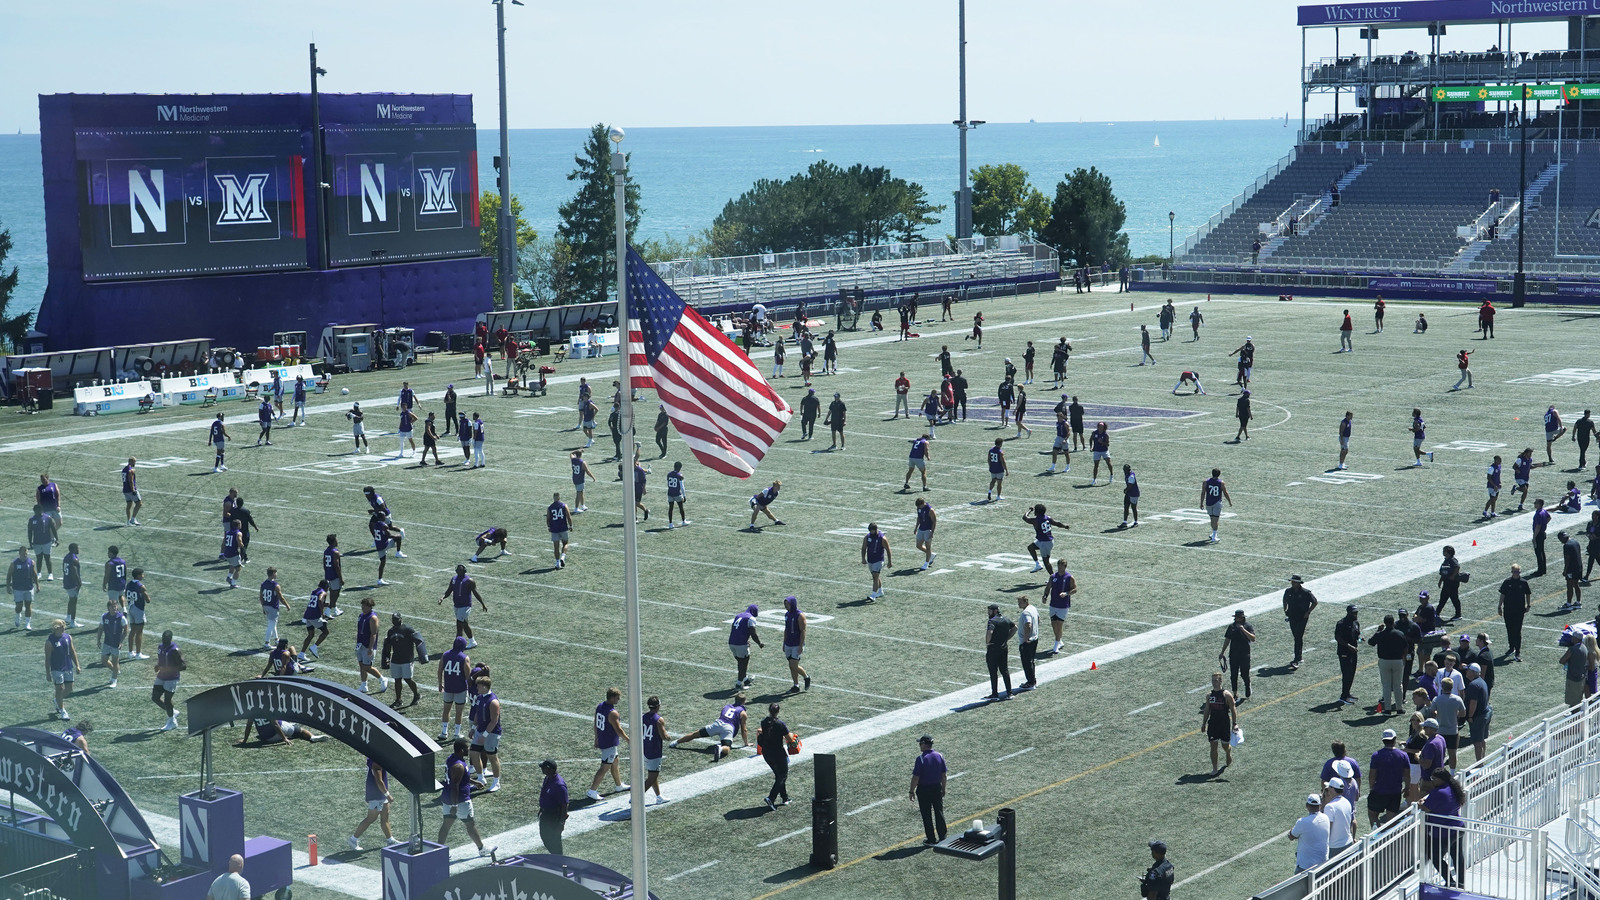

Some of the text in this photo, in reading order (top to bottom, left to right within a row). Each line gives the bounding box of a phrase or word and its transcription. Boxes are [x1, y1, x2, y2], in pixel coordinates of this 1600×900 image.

[1490, 0, 1587, 14] Northwestern
[180, 105, 228, 113] Northwestern
[392, 104, 425, 112] Northwestern
[360, 163, 387, 223] N
[418, 167, 458, 215] M
[128, 169, 167, 234] N
[213, 173, 272, 225] M
[213, 426, 218, 435] 5
[913, 440, 920, 449] 2
[668, 477, 678, 488] 28
[1208, 485, 1220, 497] 78
[551, 508, 564, 521] 34
[225, 534, 233, 547] 31
[262, 588, 273, 603] 48
[733, 616, 743, 630] 4
[444, 660, 461, 676] 44
[230, 684, 372, 744] Northwestern
[724, 707, 736, 719] 6
[181, 803, 209, 863] N
